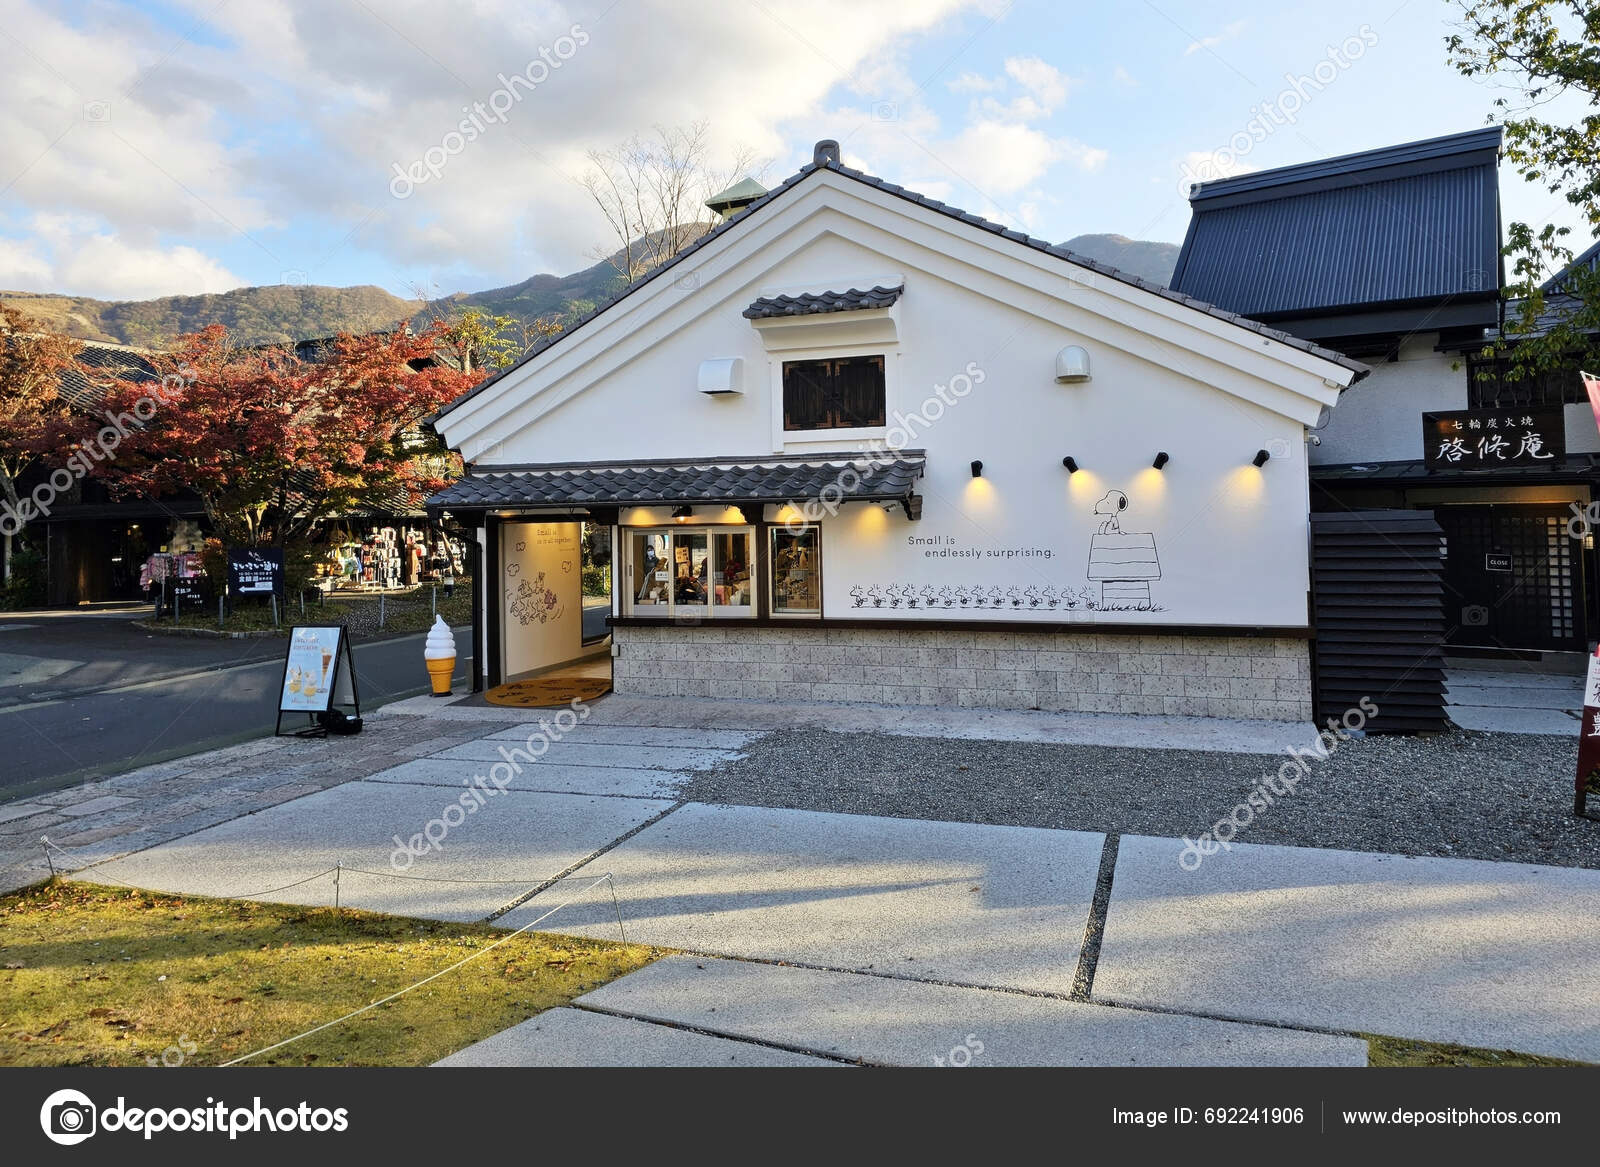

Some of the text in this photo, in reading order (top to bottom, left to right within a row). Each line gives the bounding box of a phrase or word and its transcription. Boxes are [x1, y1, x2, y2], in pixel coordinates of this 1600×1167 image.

[1452, 415, 1534, 430] 七輪炭火焼
[908, 536, 956, 545] Small is
[925, 547, 1056, 559] endlessly surprising.
